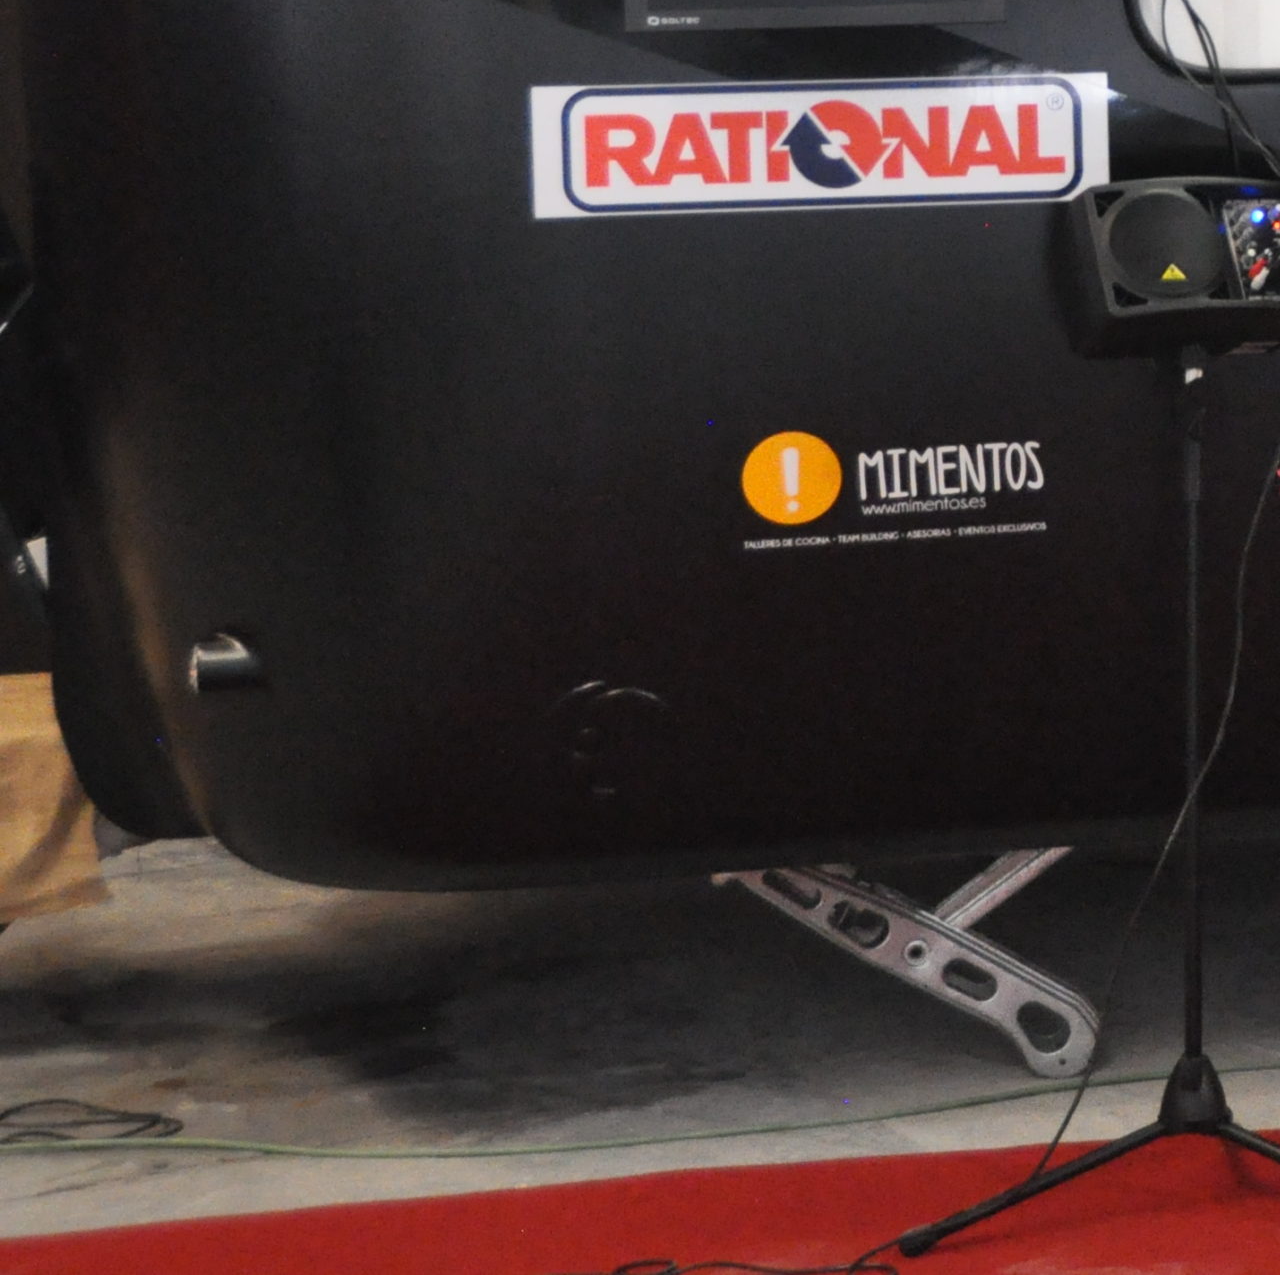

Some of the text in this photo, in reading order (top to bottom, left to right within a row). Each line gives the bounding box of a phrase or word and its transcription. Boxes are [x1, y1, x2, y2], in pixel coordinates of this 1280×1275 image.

[584, 98, 1066, 188] RATIONAL
[858, 441, 1044, 500] MIMENTOS
[861, 495, 987, 515] www.mimentos.es
[743, 538, 781, 550] TALLERES
[782, 537, 793, 548] DE
[795, 536, 831, 547] COCINA
[837, 534, 860, 544] TEAM
[861, 531, 899, 543] BUILDING
[958, 525, 996, 537] EVENTOS
[996, 522, 1047, 534] EXCLUSIVOS
